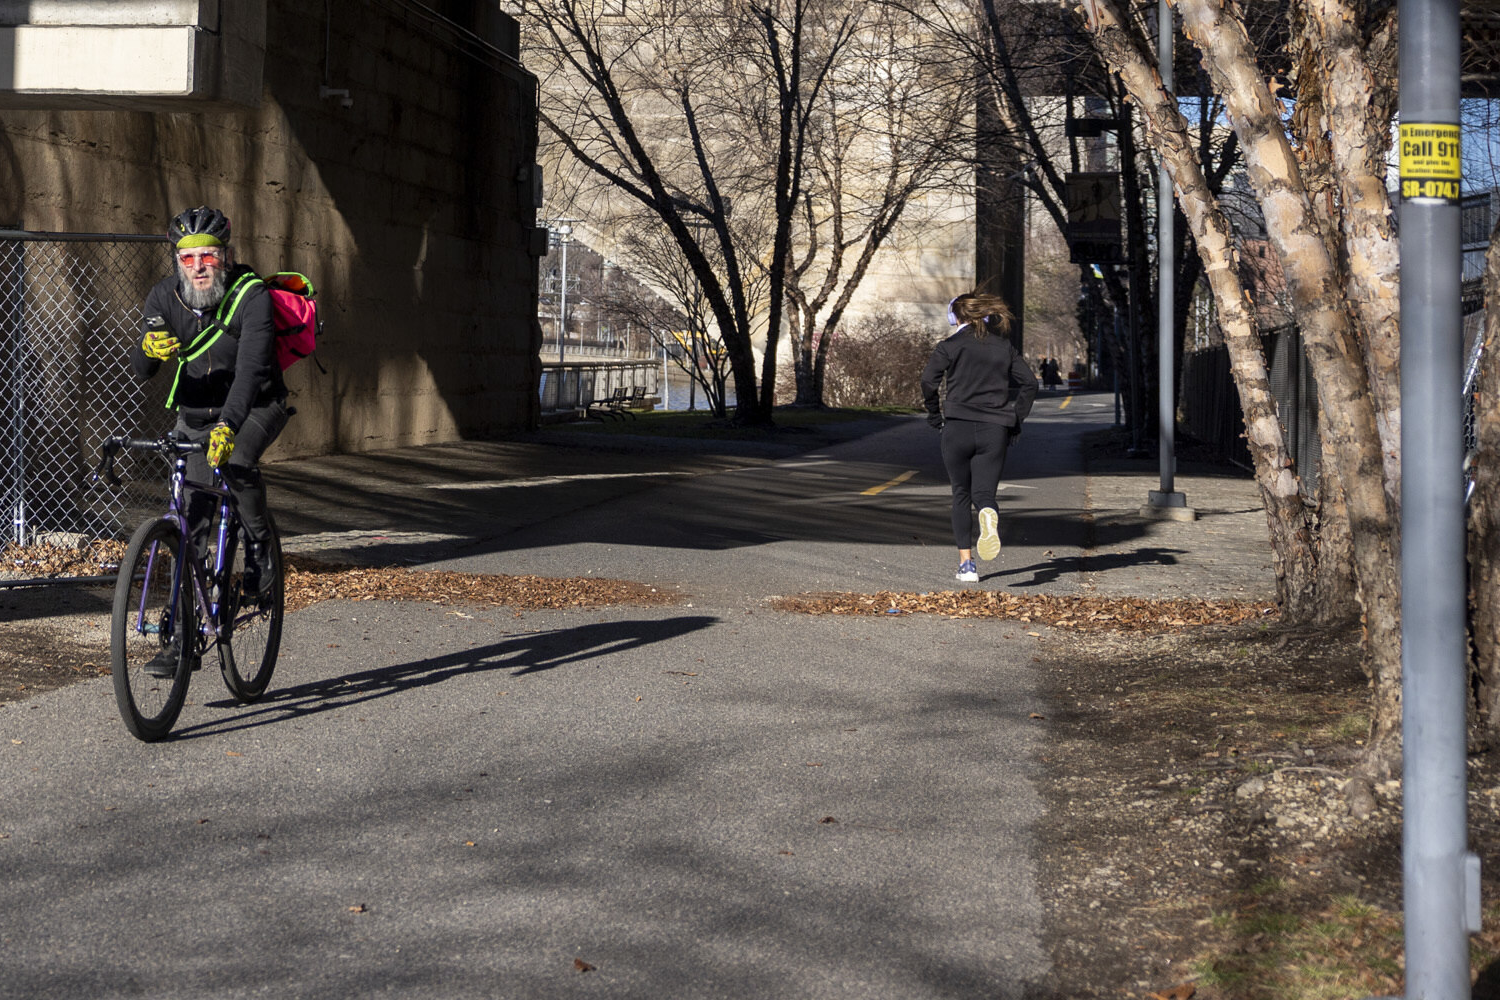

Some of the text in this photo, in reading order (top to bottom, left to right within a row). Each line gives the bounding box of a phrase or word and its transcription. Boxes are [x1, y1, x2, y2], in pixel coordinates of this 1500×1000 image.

[1403, 141, 1460, 159] Call 911
[1402, 180, 1460, 199] SR-074.7
